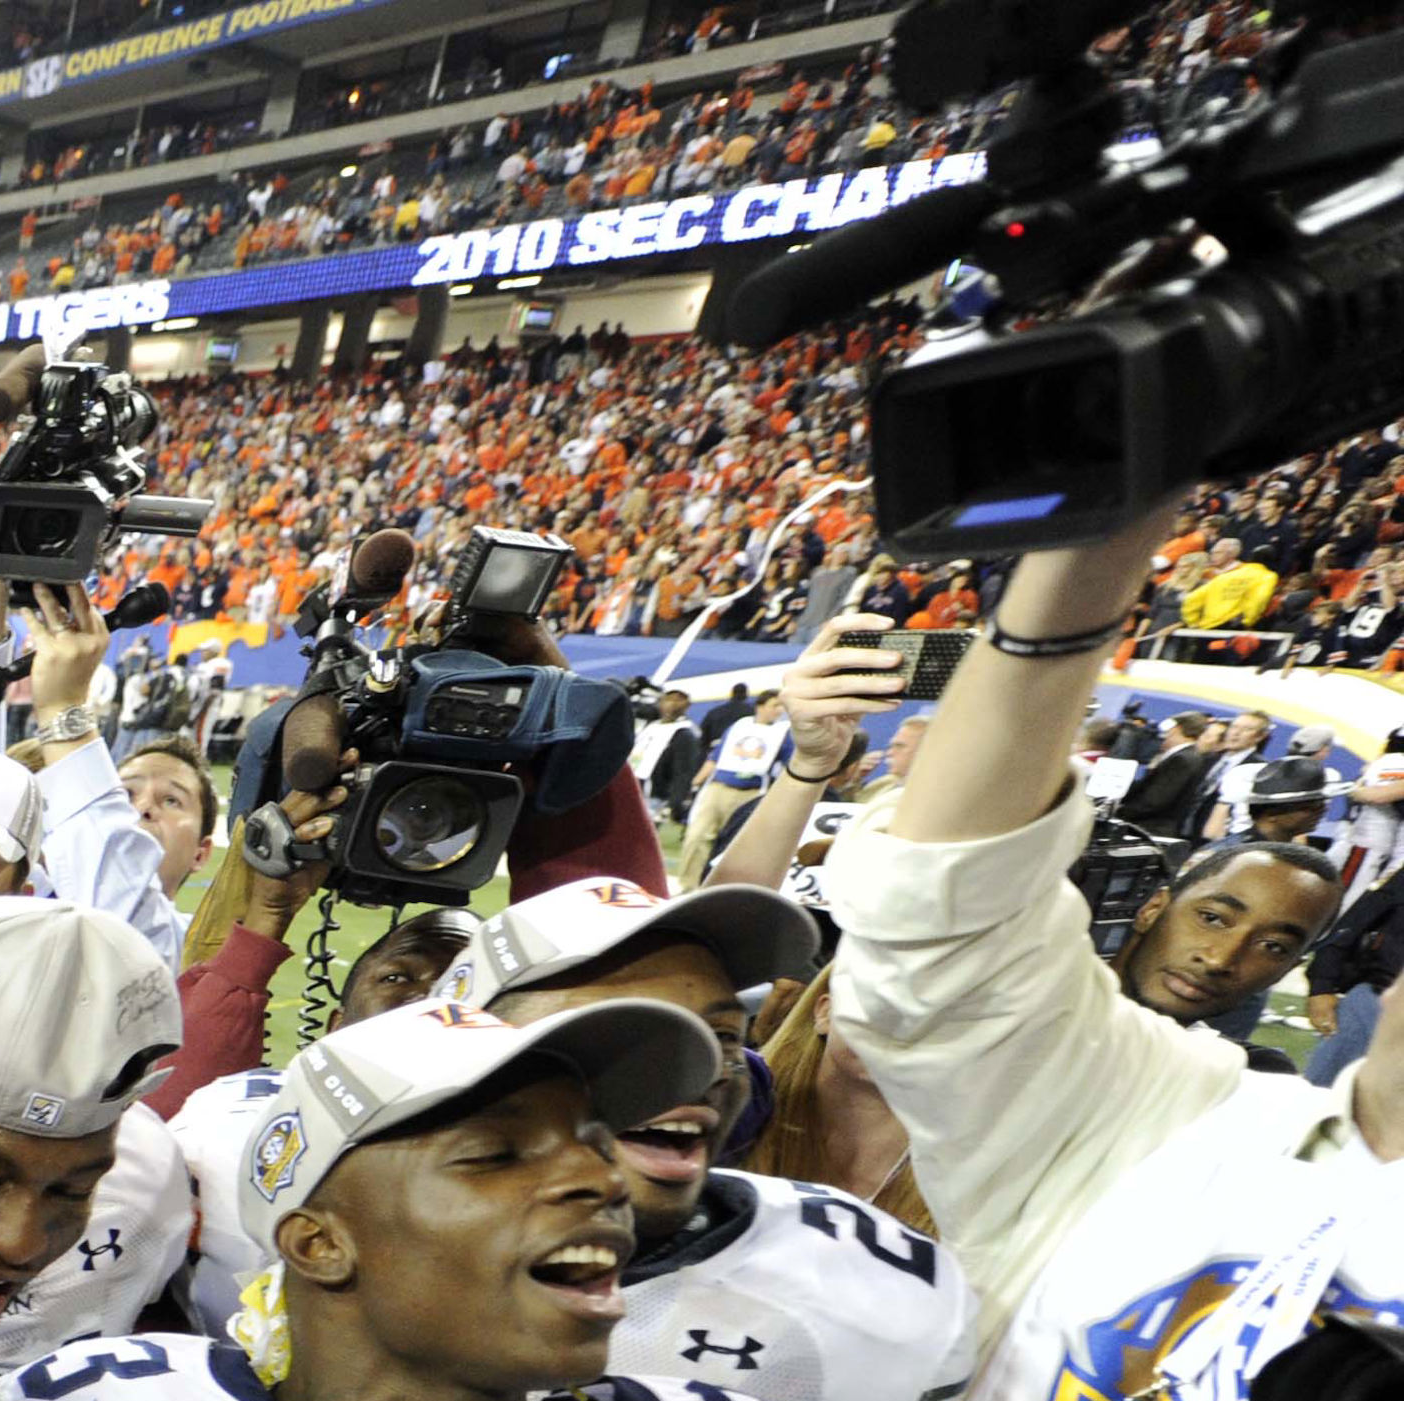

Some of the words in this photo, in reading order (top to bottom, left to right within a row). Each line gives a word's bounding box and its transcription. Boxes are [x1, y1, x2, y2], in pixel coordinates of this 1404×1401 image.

[66, 21, 222, 79] CONFERENCE
[226, 0, 353, 36] FOOTB
[411, 219, 564, 286] 2010
[568, 194, 714, 265] SEC
[14, 279, 171, 340] TIGERS
